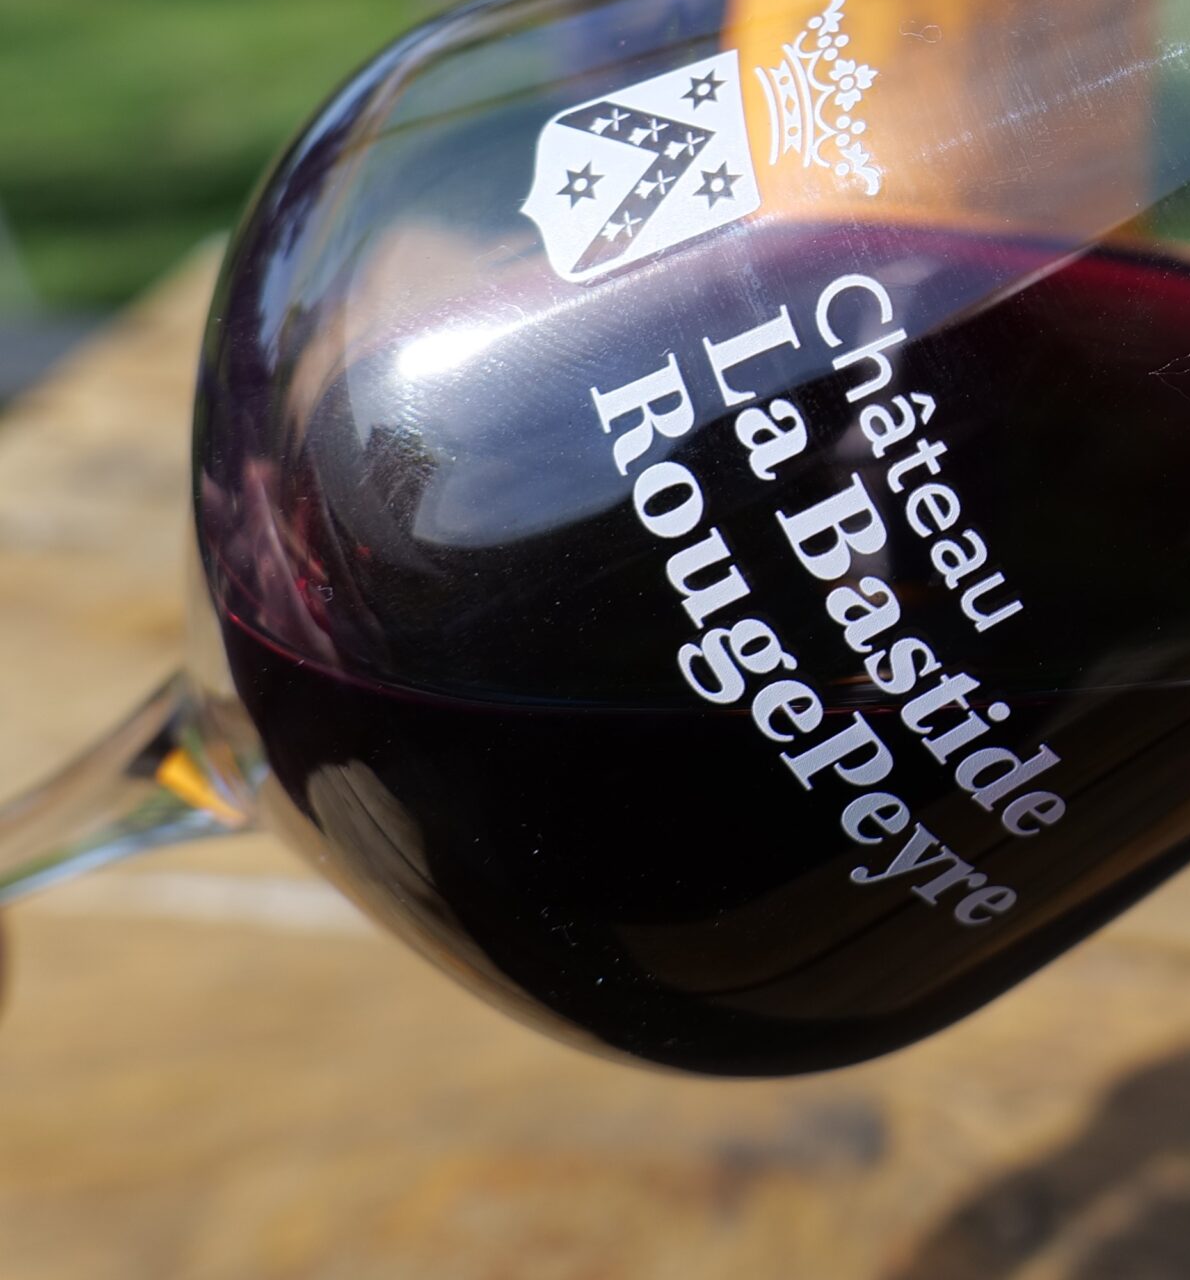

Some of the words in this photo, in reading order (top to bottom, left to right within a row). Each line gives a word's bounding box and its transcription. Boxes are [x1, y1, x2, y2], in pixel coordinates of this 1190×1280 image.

[590, 352, 1017, 926] RougePeyre
[702, 304, 807, 480] La
[775, 472, 1066, 837] Bastide
[815, 274, 1022, 632] Château
